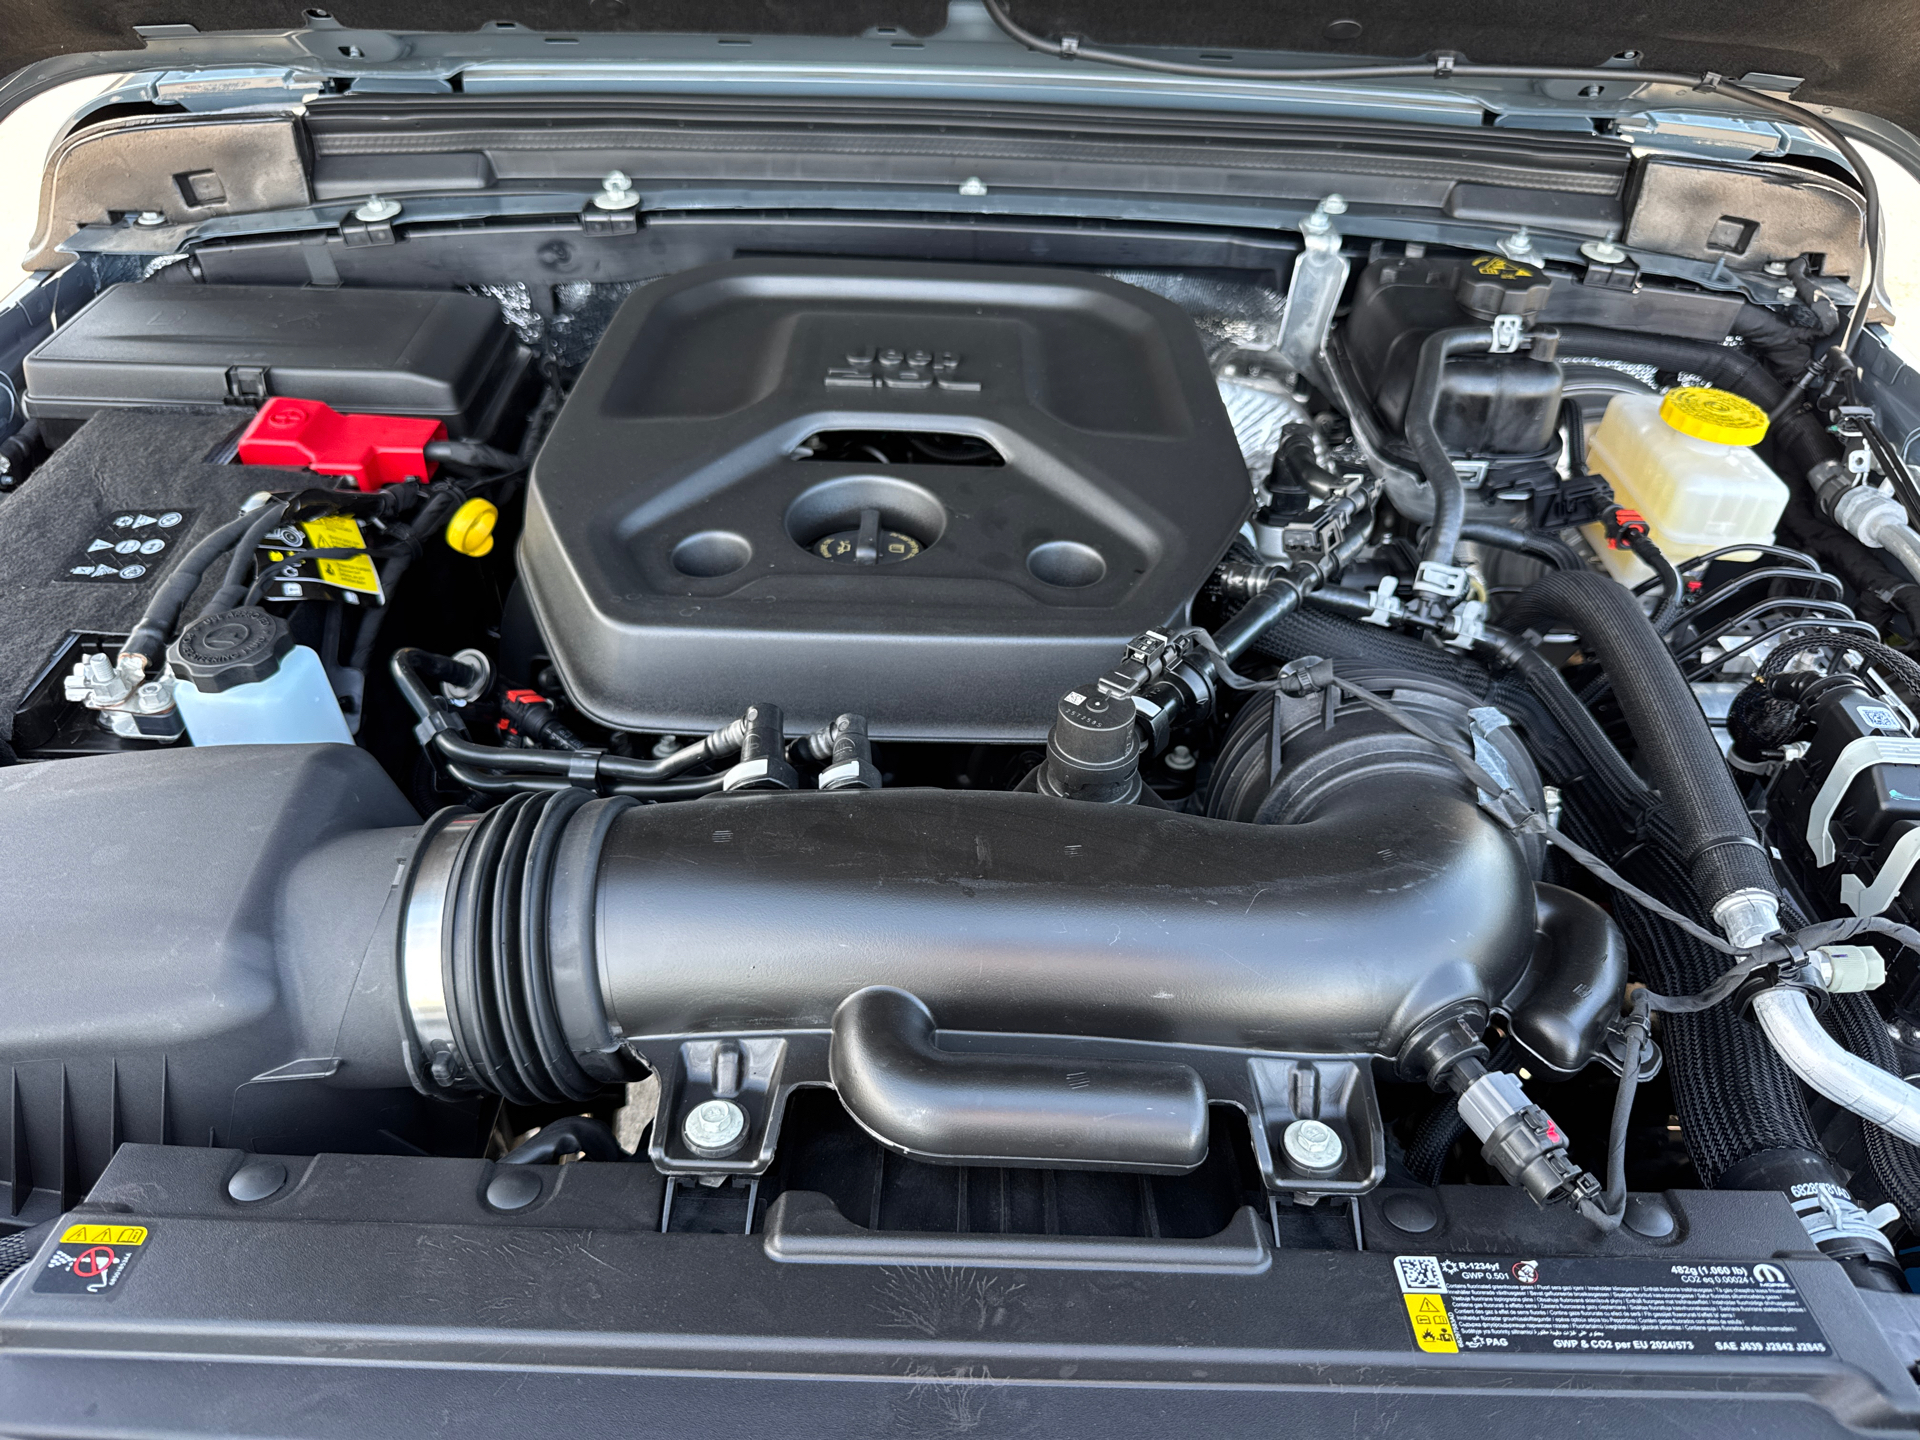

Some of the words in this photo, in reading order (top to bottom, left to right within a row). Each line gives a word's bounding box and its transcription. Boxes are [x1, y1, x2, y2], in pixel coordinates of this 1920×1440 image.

[845, 344, 961, 371] Jeep
[1790, 1181, 1851, 1200] 682881AD
[1458, 1262, 1500, 1271] R-1234yf
[1671, 1265, 1698, 1276] 482g
[1461, 1271, 1484, 1279] GWP
[1485, 1272, 1510, 1280] 0.501
[1681, 1275, 1702, 1283] CO2
[1702, 1276, 1715, 1284] eq
[1715, 1276, 1749, 1284] 0.00024
[1486, 1337, 1508, 1346] PAG
[1553, 1339, 1578, 1348] GWP
[1580, 1340, 1589, 1348] &
[1591, 1340, 1613, 1349] CO2
[1615, 1342, 1631, 1350] per
[1633, 1341, 1648, 1349] EU
[1650, 1341, 1694, 1350] 2024/573
[1714, 1342, 1738, 1351] SAE
[1740, 1342, 1763, 1351] J639
